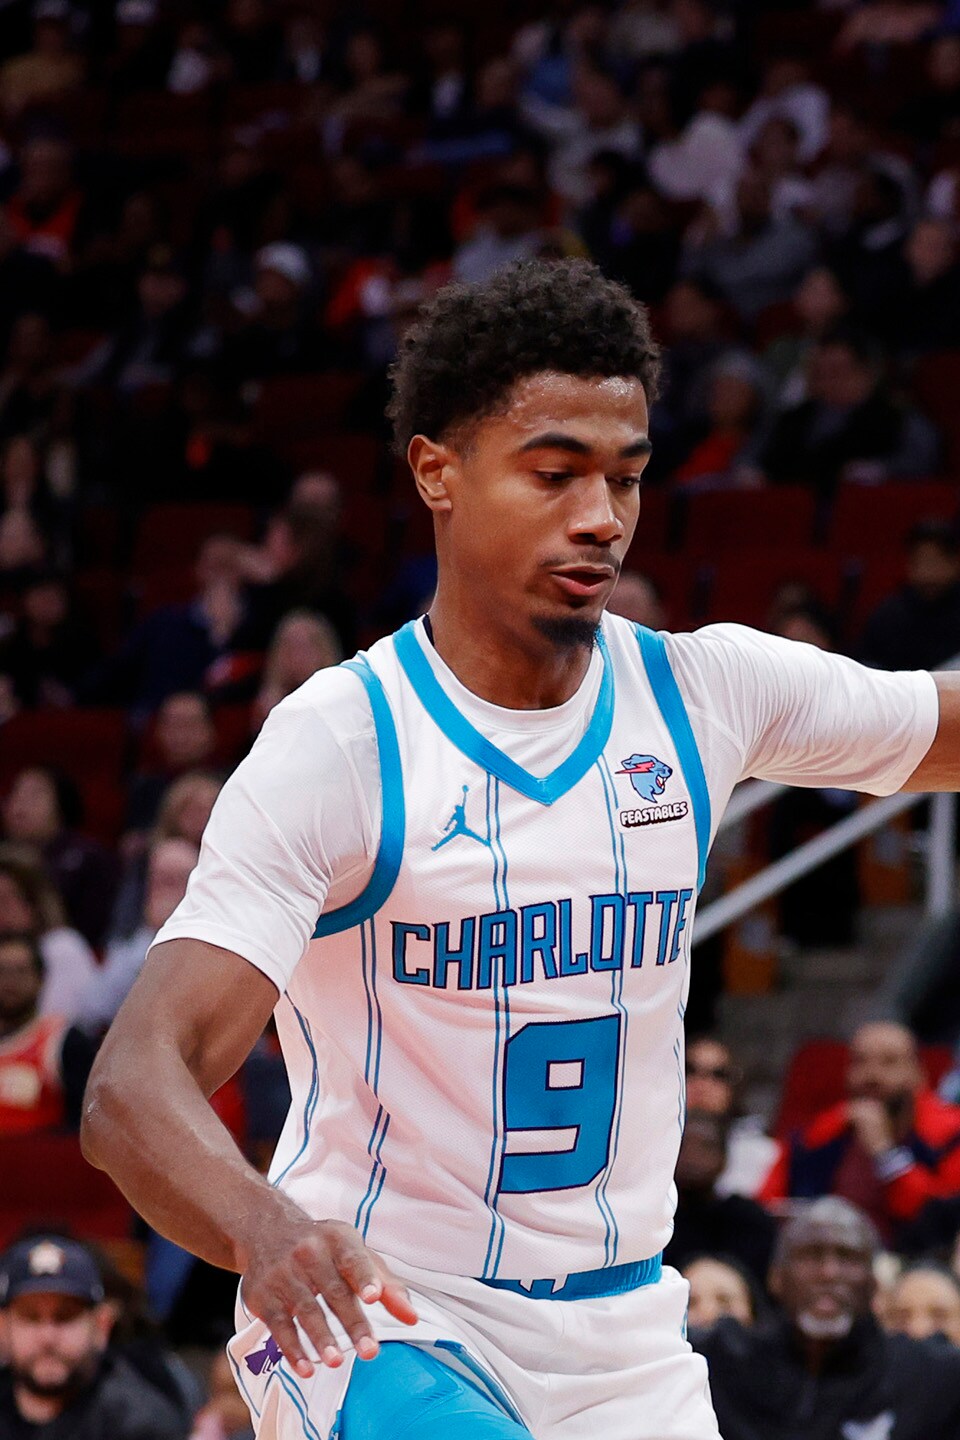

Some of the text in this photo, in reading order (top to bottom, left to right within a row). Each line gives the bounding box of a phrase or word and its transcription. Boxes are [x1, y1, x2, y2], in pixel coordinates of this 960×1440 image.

[620, 801, 688, 828] FEASTABLES
[390, 888, 693, 991] CHARLOTTE
[497, 1013, 622, 1195] 9
